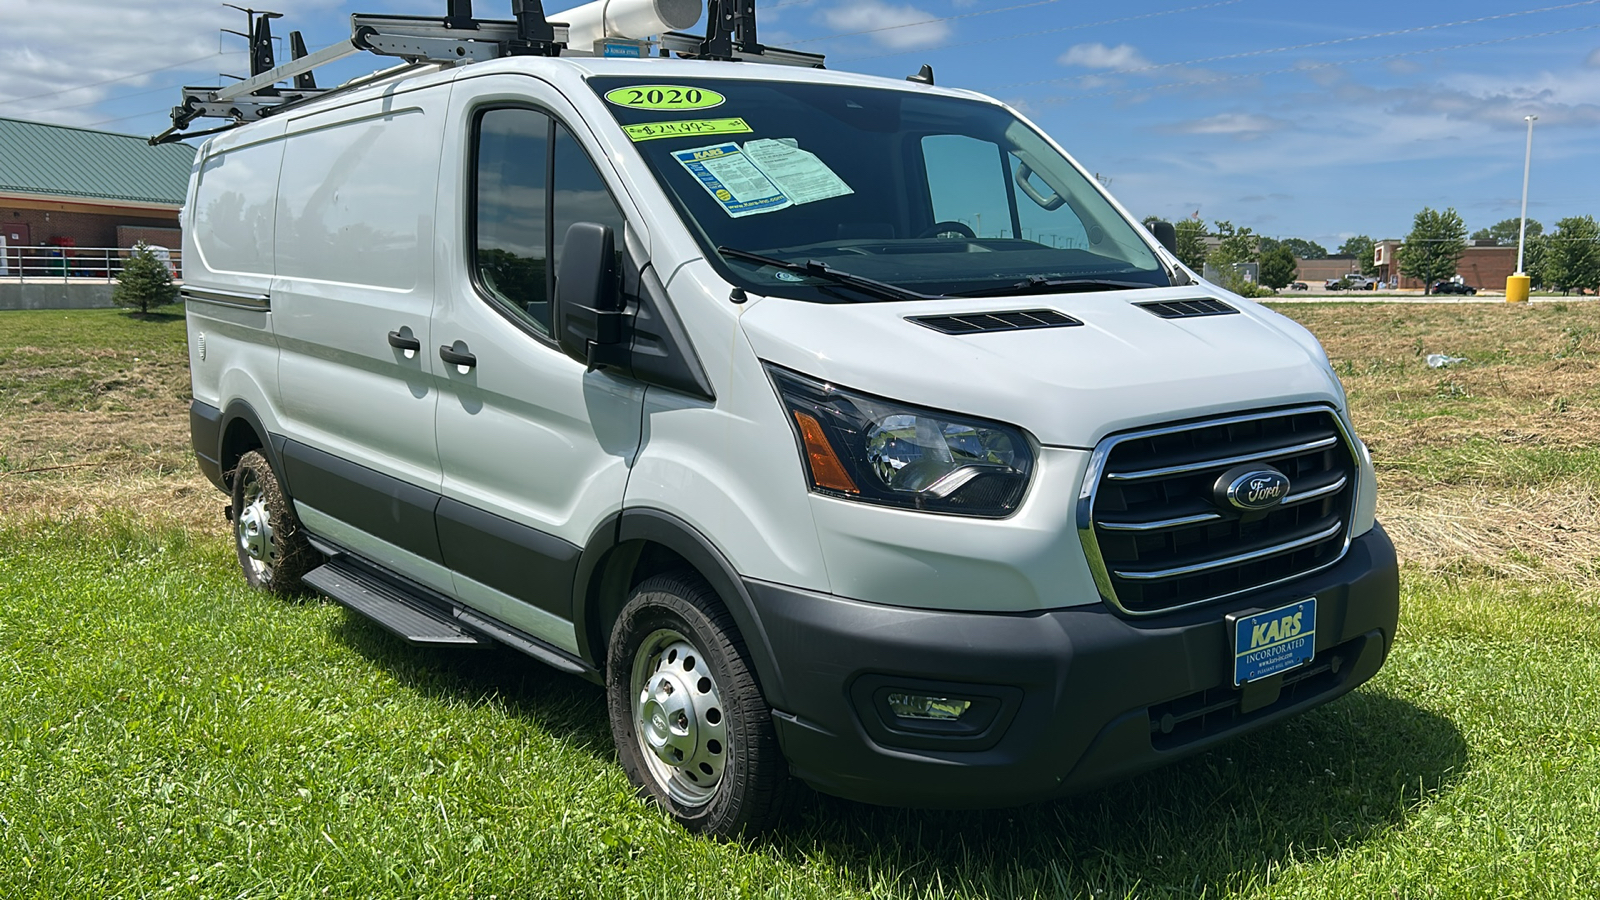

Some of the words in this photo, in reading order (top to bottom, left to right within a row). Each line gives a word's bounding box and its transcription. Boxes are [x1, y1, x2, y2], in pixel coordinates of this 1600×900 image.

[628, 89, 702, 104] 2020
[693, 148, 724, 159] KARS
[1248, 477, 1281, 502] Ford
[1250, 612, 1302, 648] KARS
[1246, 638, 1305, 664] INCORPORATED
